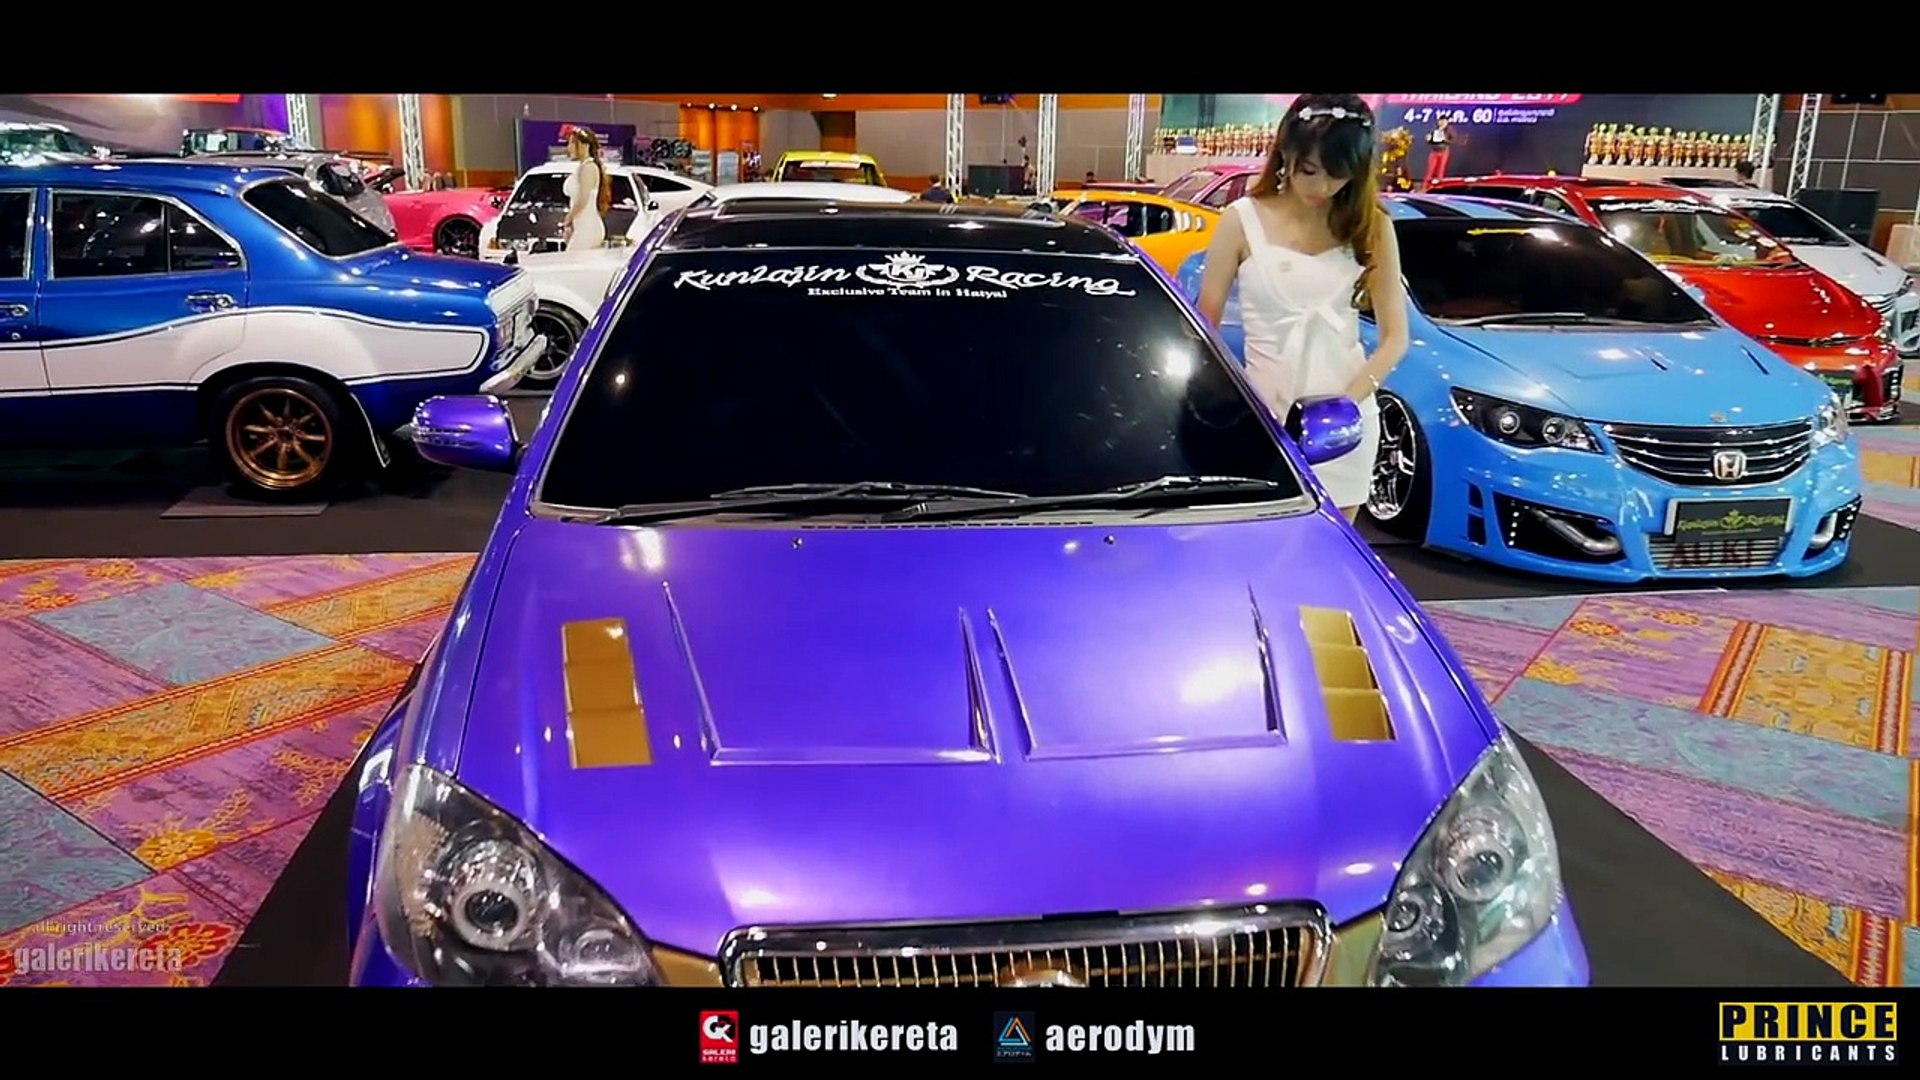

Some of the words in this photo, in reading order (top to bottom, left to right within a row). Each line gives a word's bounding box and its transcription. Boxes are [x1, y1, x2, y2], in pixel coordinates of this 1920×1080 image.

[1403, 107, 1433, 123] 4-7
[1472, 107, 1493, 123] 60
[966, 265, 1137, 296] Racing
[807, 287, 885, 296] Exclusive
[886, 287, 932, 297] Team
